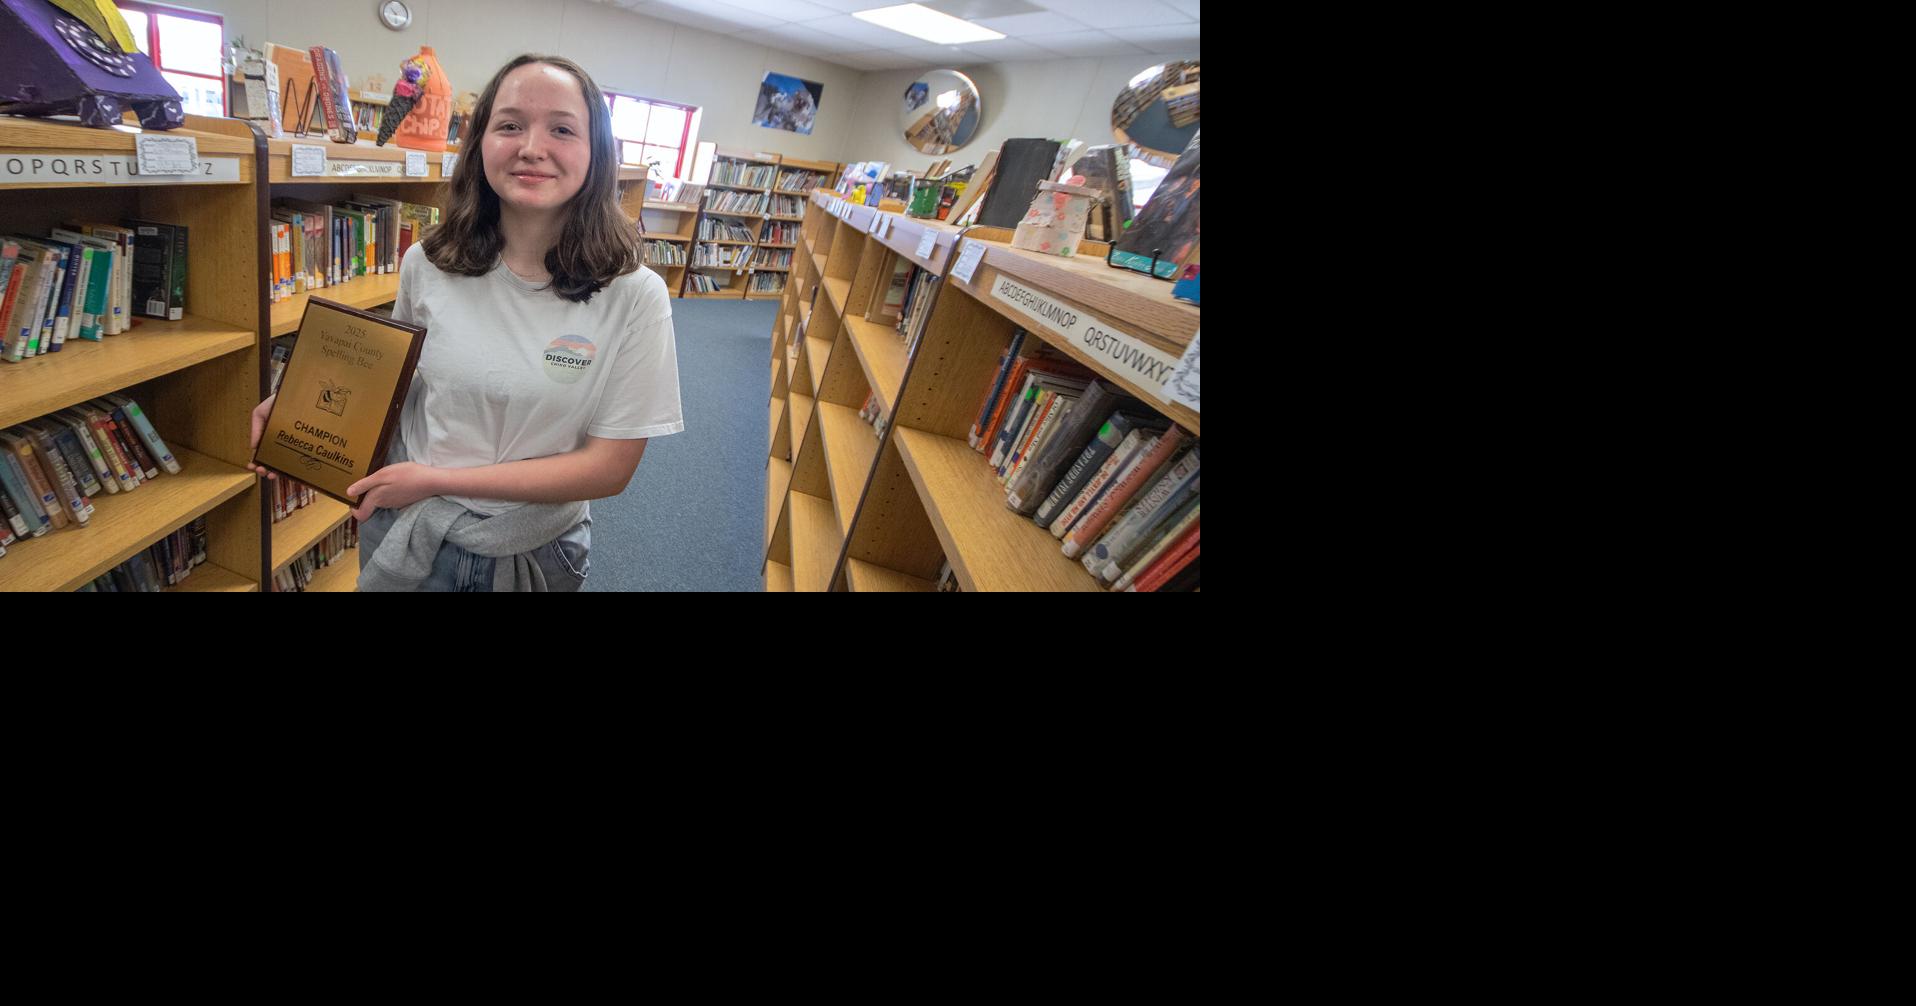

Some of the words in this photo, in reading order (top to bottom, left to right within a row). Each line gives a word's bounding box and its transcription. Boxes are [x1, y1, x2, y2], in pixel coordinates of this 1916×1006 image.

[344, 324, 367, 338] 2025
[353, 341, 384, 361] County
[545, 353, 592, 366] DISCOVER
[357, 356, 373, 370] Bee
[294, 420, 348, 448] CHAMPION
[277, 430, 313, 452] Rebecca
[316, 445, 354, 468] Caulkins
